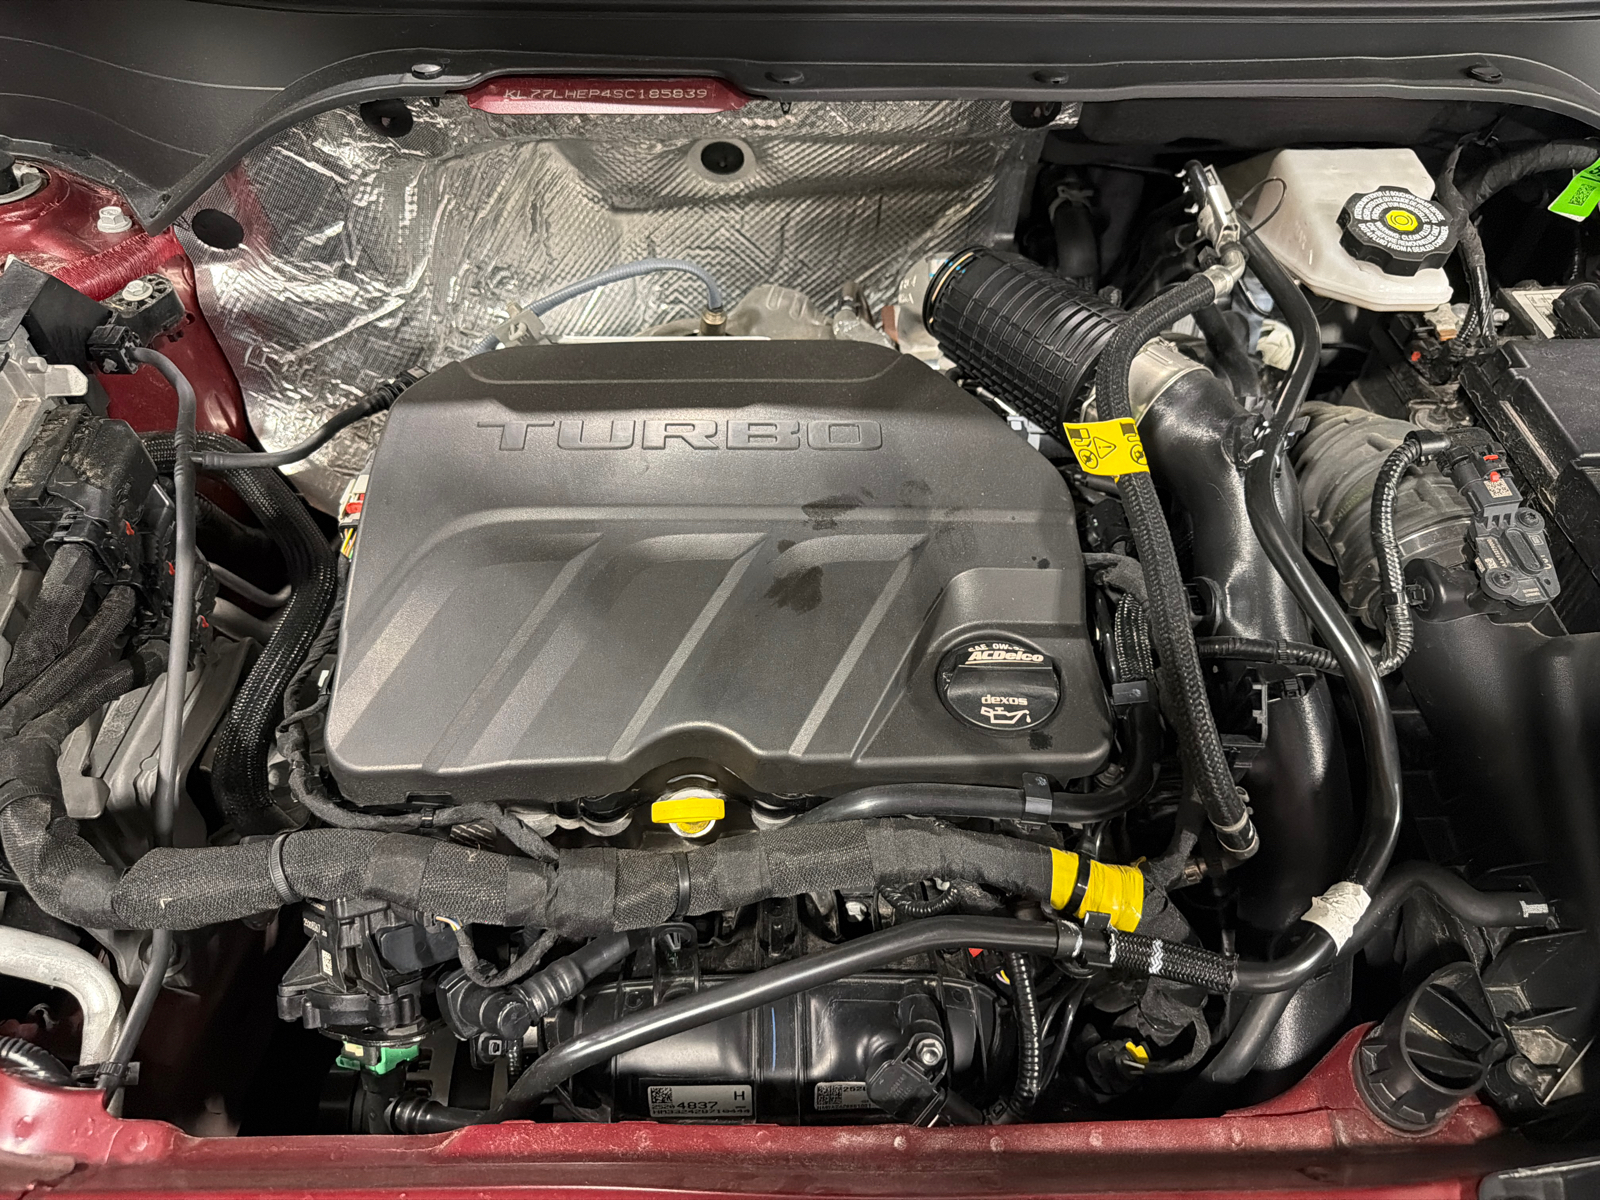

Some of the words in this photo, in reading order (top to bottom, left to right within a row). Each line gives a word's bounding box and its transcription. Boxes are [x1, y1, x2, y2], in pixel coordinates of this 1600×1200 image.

[503, 88, 708, 99] KL77LHEP4SC185839
[1368, 234, 1388, 246] FLUID
[1387, 242, 1406, 252] FROM
[1411, 243, 1435, 252] SEALED
[476, 419, 883, 451] TURBO
[967, 650, 1044, 662] ACDelco
[981, 694, 1028, 706] dexos
[734, 1090, 745, 1101] H
[677, 1101, 718, 1110] 4837
